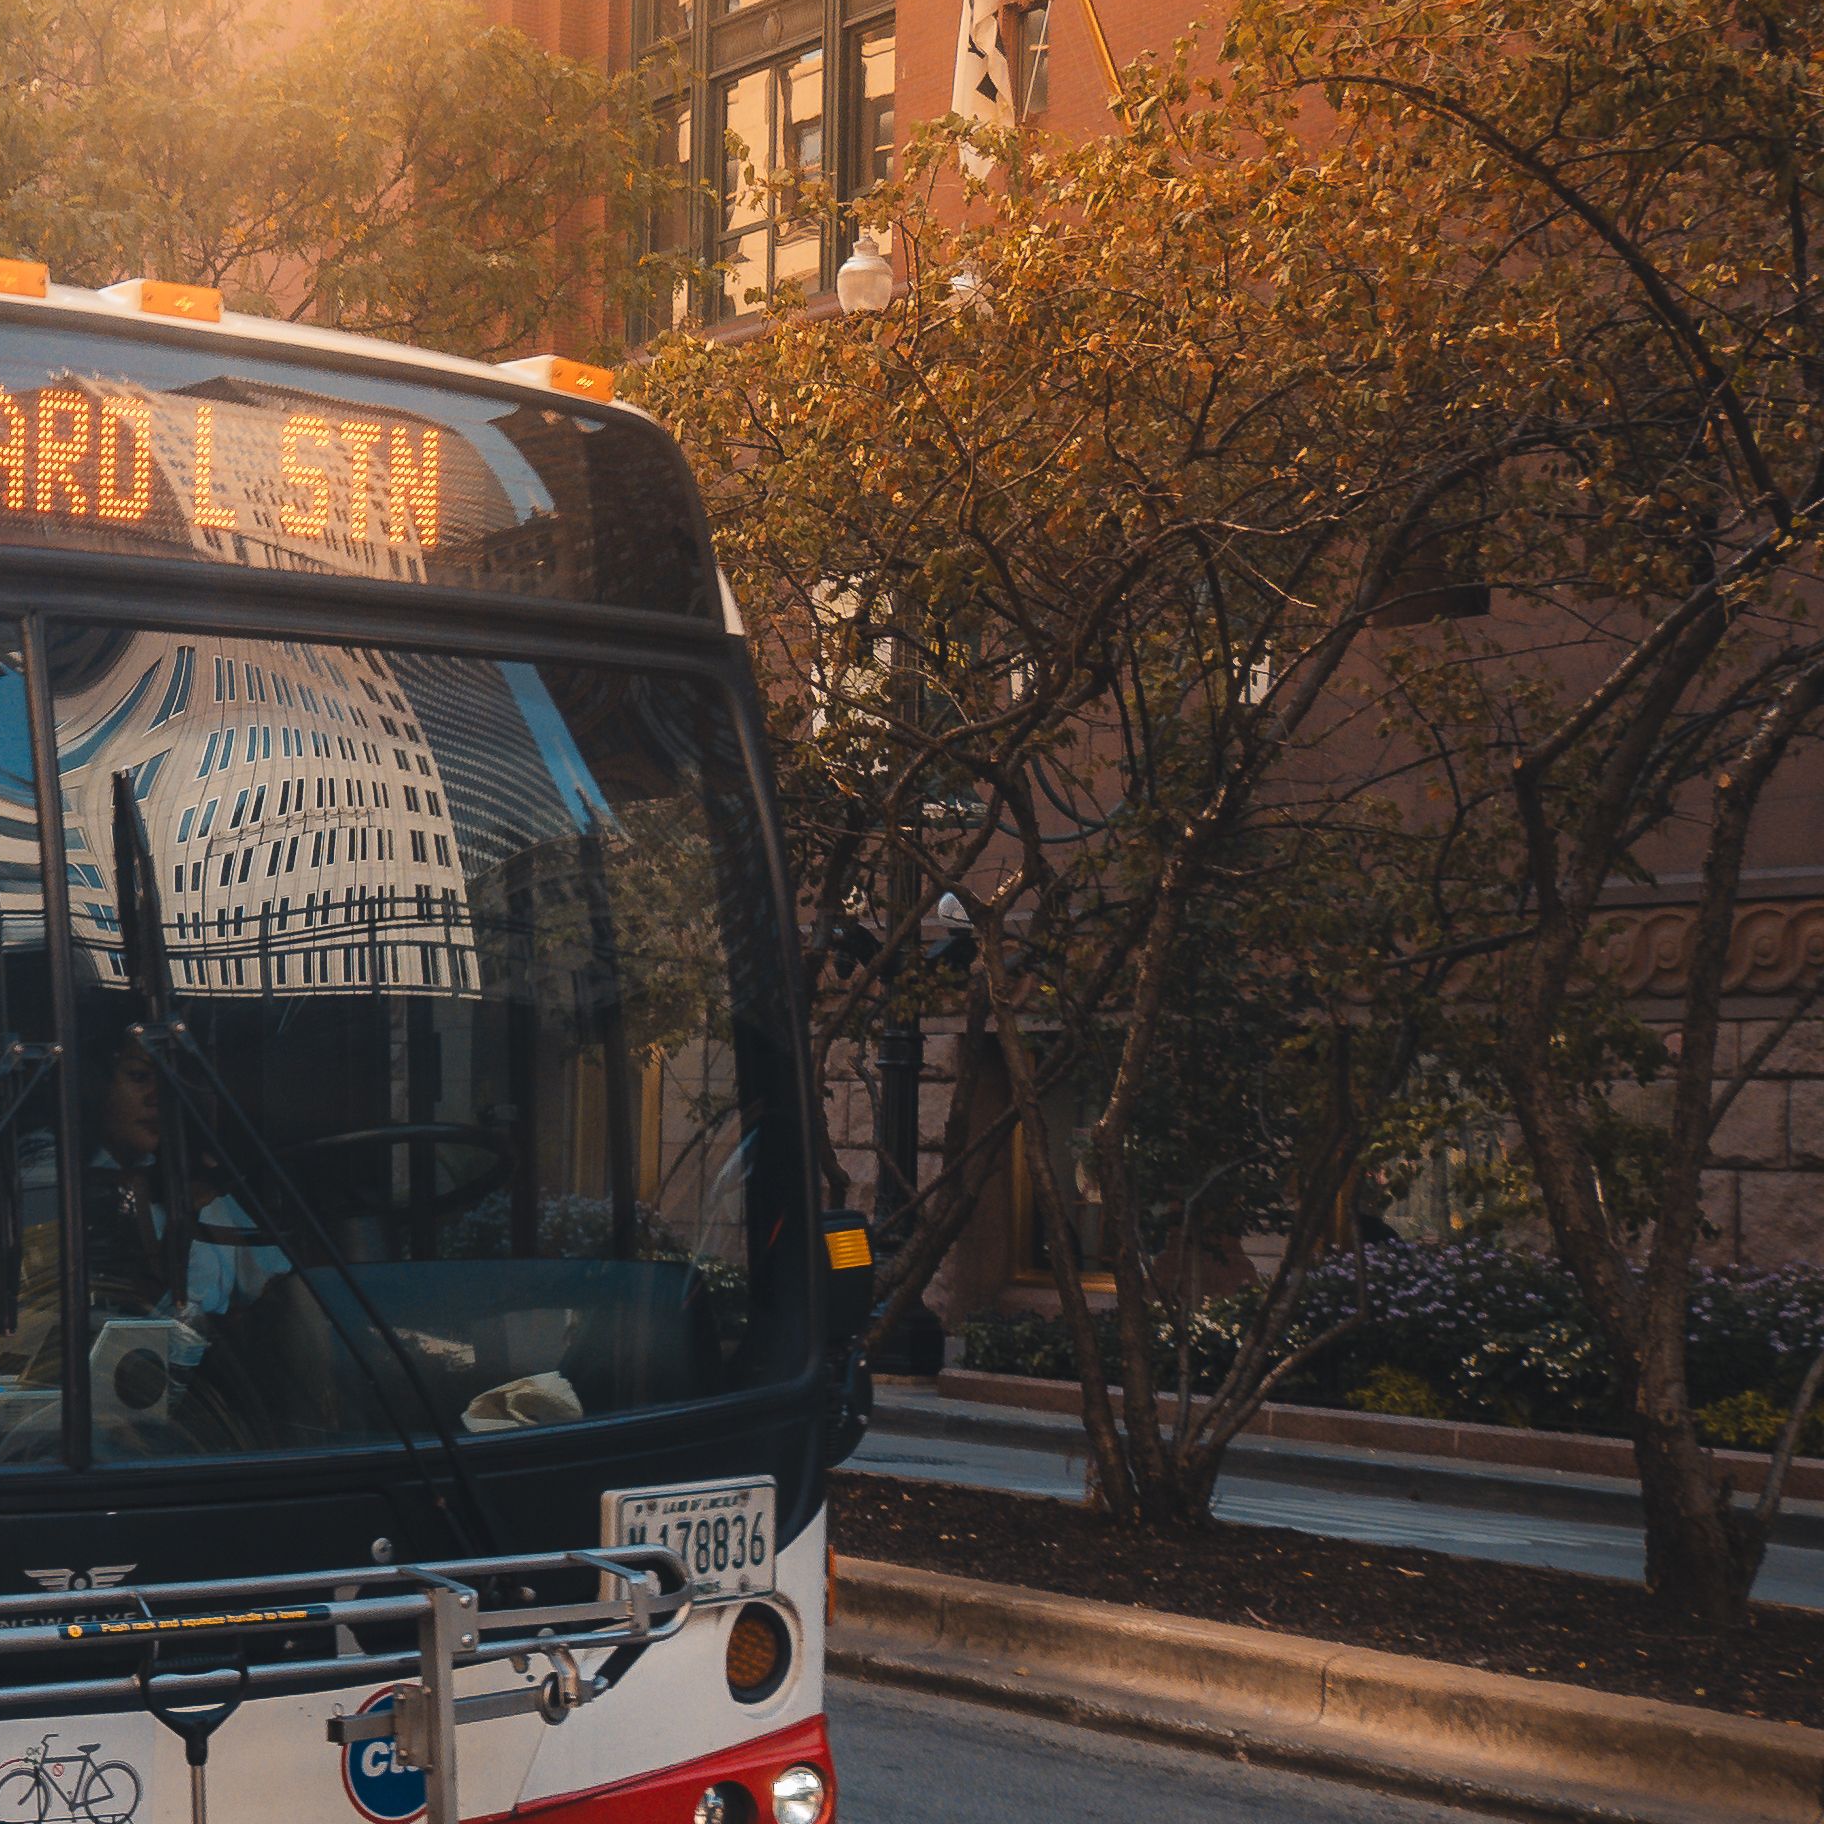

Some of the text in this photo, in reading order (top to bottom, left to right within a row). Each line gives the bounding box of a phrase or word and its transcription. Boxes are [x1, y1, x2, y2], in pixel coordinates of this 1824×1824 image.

[193, 404, 238, 527] L
[279, 414, 441, 546] STN
[361, 1741, 421, 1777] ct
